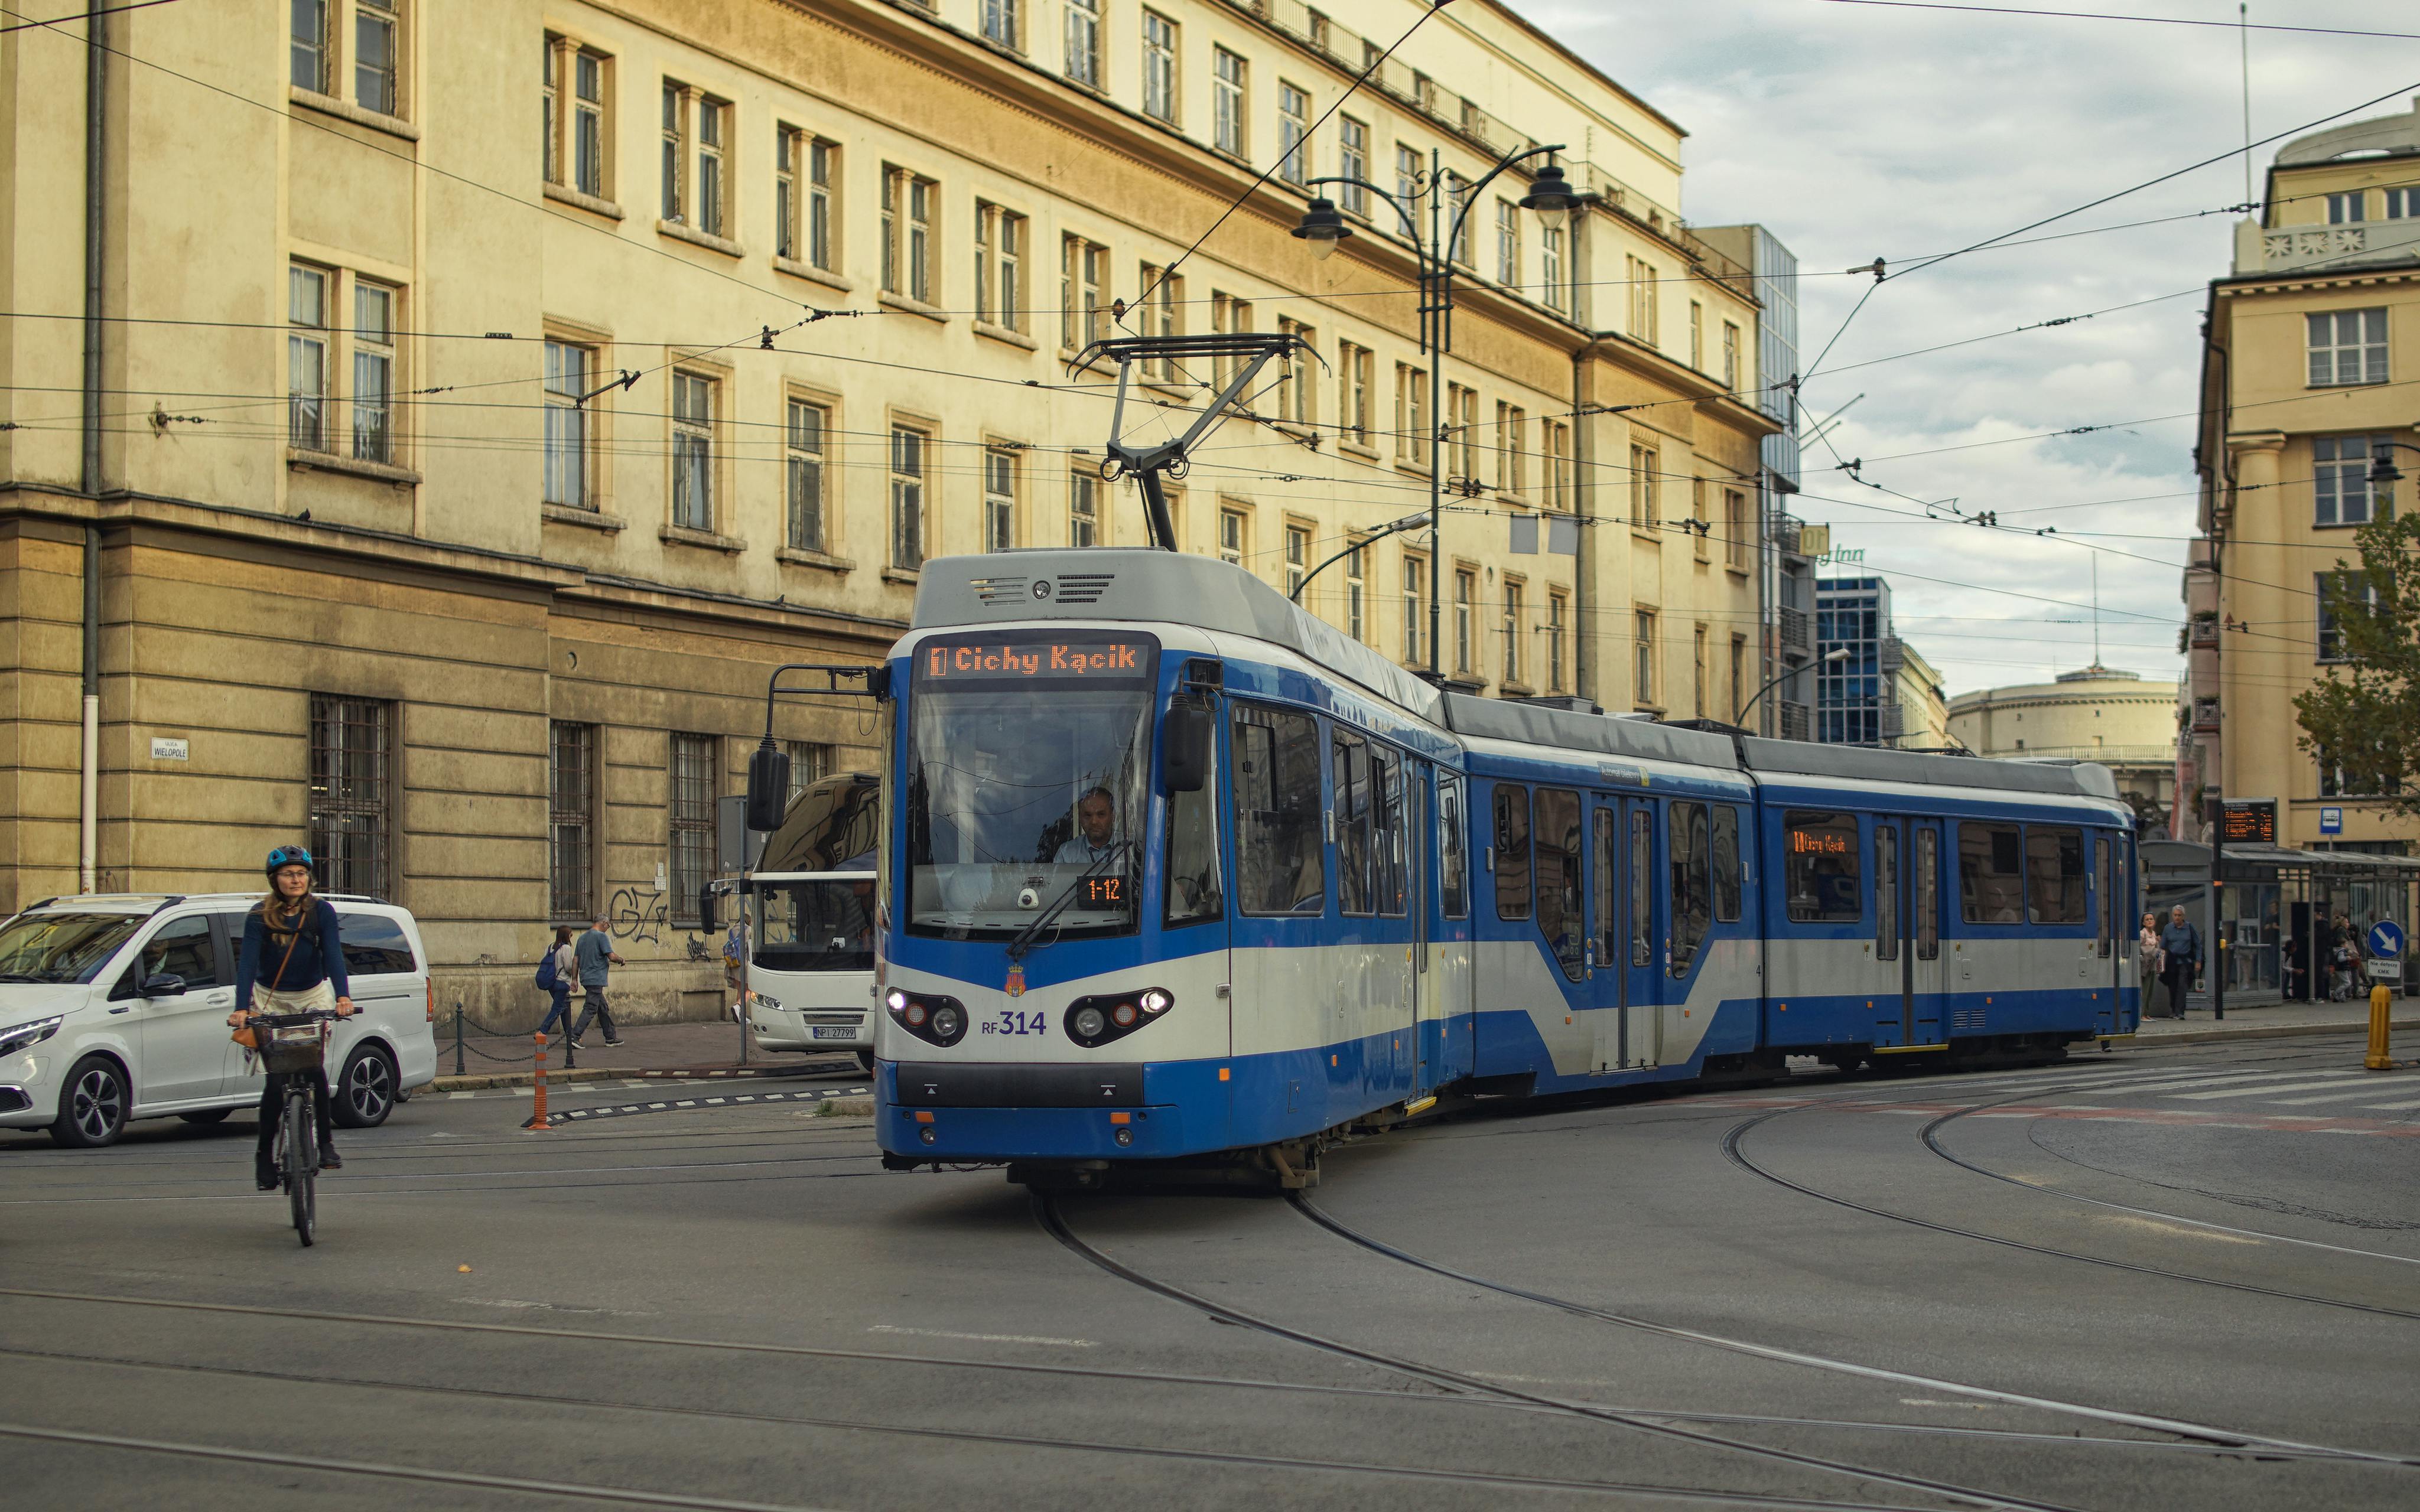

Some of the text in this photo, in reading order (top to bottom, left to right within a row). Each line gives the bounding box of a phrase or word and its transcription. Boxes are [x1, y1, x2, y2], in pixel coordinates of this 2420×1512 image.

[930, 644, 1136, 676] 1 Cichy Kącik
[154, 747, 186, 758] WIELOPOLE
[1088, 879, 1120, 900] 1-12
[832, 1028, 854, 1037] 27799
